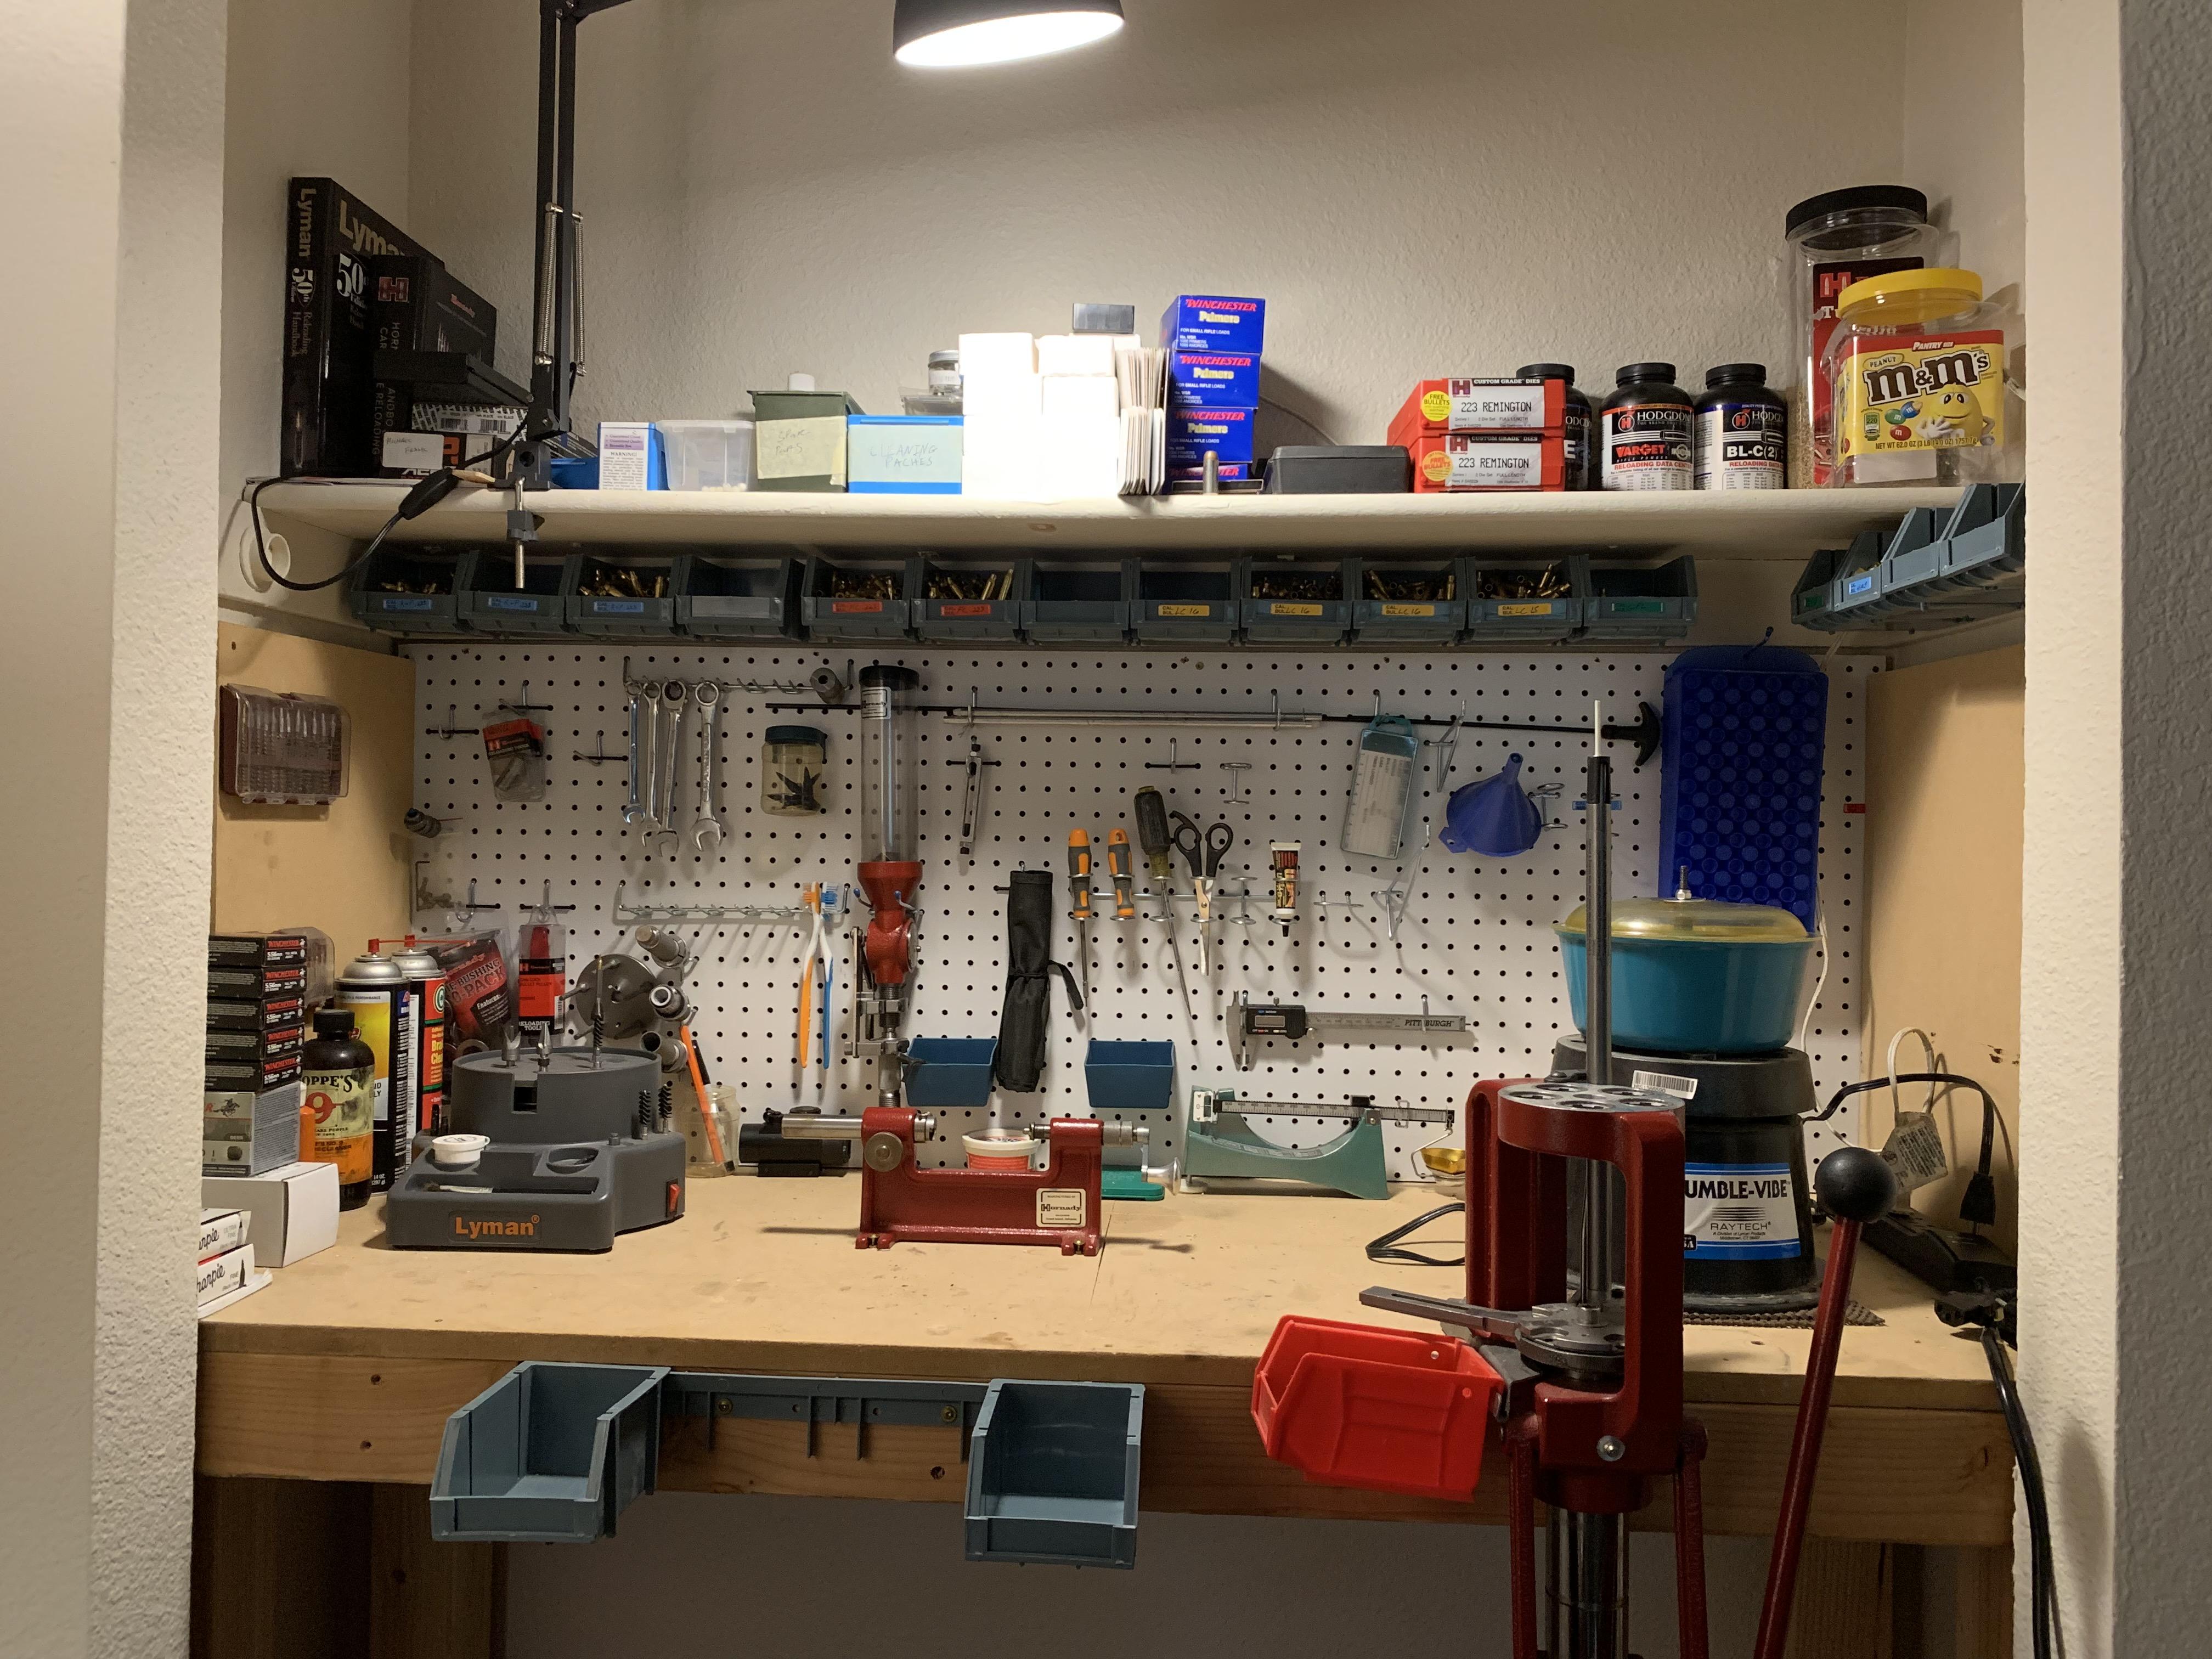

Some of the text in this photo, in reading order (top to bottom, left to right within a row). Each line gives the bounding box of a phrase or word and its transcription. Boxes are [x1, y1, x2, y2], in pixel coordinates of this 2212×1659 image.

[297, 188, 317, 257] Lyman
[1185, 298, 1257, 312] WINCHESTER
[1199, 310, 1240, 324] Primers
[1912, 342, 1942, 351] PANTRY
[1180, 356, 1251, 366] WINCHESTER
[1870, 356, 1897, 368] PEANUT
[1193, 366, 1235, 380] Primers
[385, 387, 396, 427] ANDBO
[1461, 402, 1477, 412] 223
[1482, 402, 1532, 412] REMINGTON
[1176, 411, 1245, 421] WINCHESTER
[1565, 415, 1592, 428] ODGDO
[1637, 410, 1690, 422] HODGDON
[1187, 422, 1228, 434] Primers
[870, 443, 938, 456] CLEANING
[1616, 444, 1666, 458] VARGET
[1726, 444, 1778, 460] BL-C(2)
[884, 457, 933, 468] PACHES
[1458, 458, 1530, 469] 223 REMINGTON
[1614, 460, 1654, 470] RELOADING
[265, 969, 299, 979] WINCHESTER
[457, 958, 500, 986] BUSHING
[451, 966, 505, 1003] 0-PACK
[267, 1000, 298, 1011] WINCHESTER
[1404, 1019, 1452, 1028] PITTBURGH
[267, 1029, 298, 1041] WINCHESTER
[431, 1039, 444, 1052] Bra
[264, 1058, 296, 1071] WINCHESTER
[302, 1075, 352, 1093] OPPE'S
[305, 1092, 337, 1125] 9
[1685, 1179, 1788, 1199] UMBLE-VIBE
[1041, 1204, 1082, 1212] Hornady
[455, 1216, 534, 1239] Lyman
[1711, 1222, 1768, 1231] RAYTECH
[196, 1263, 225, 1293] harpie
